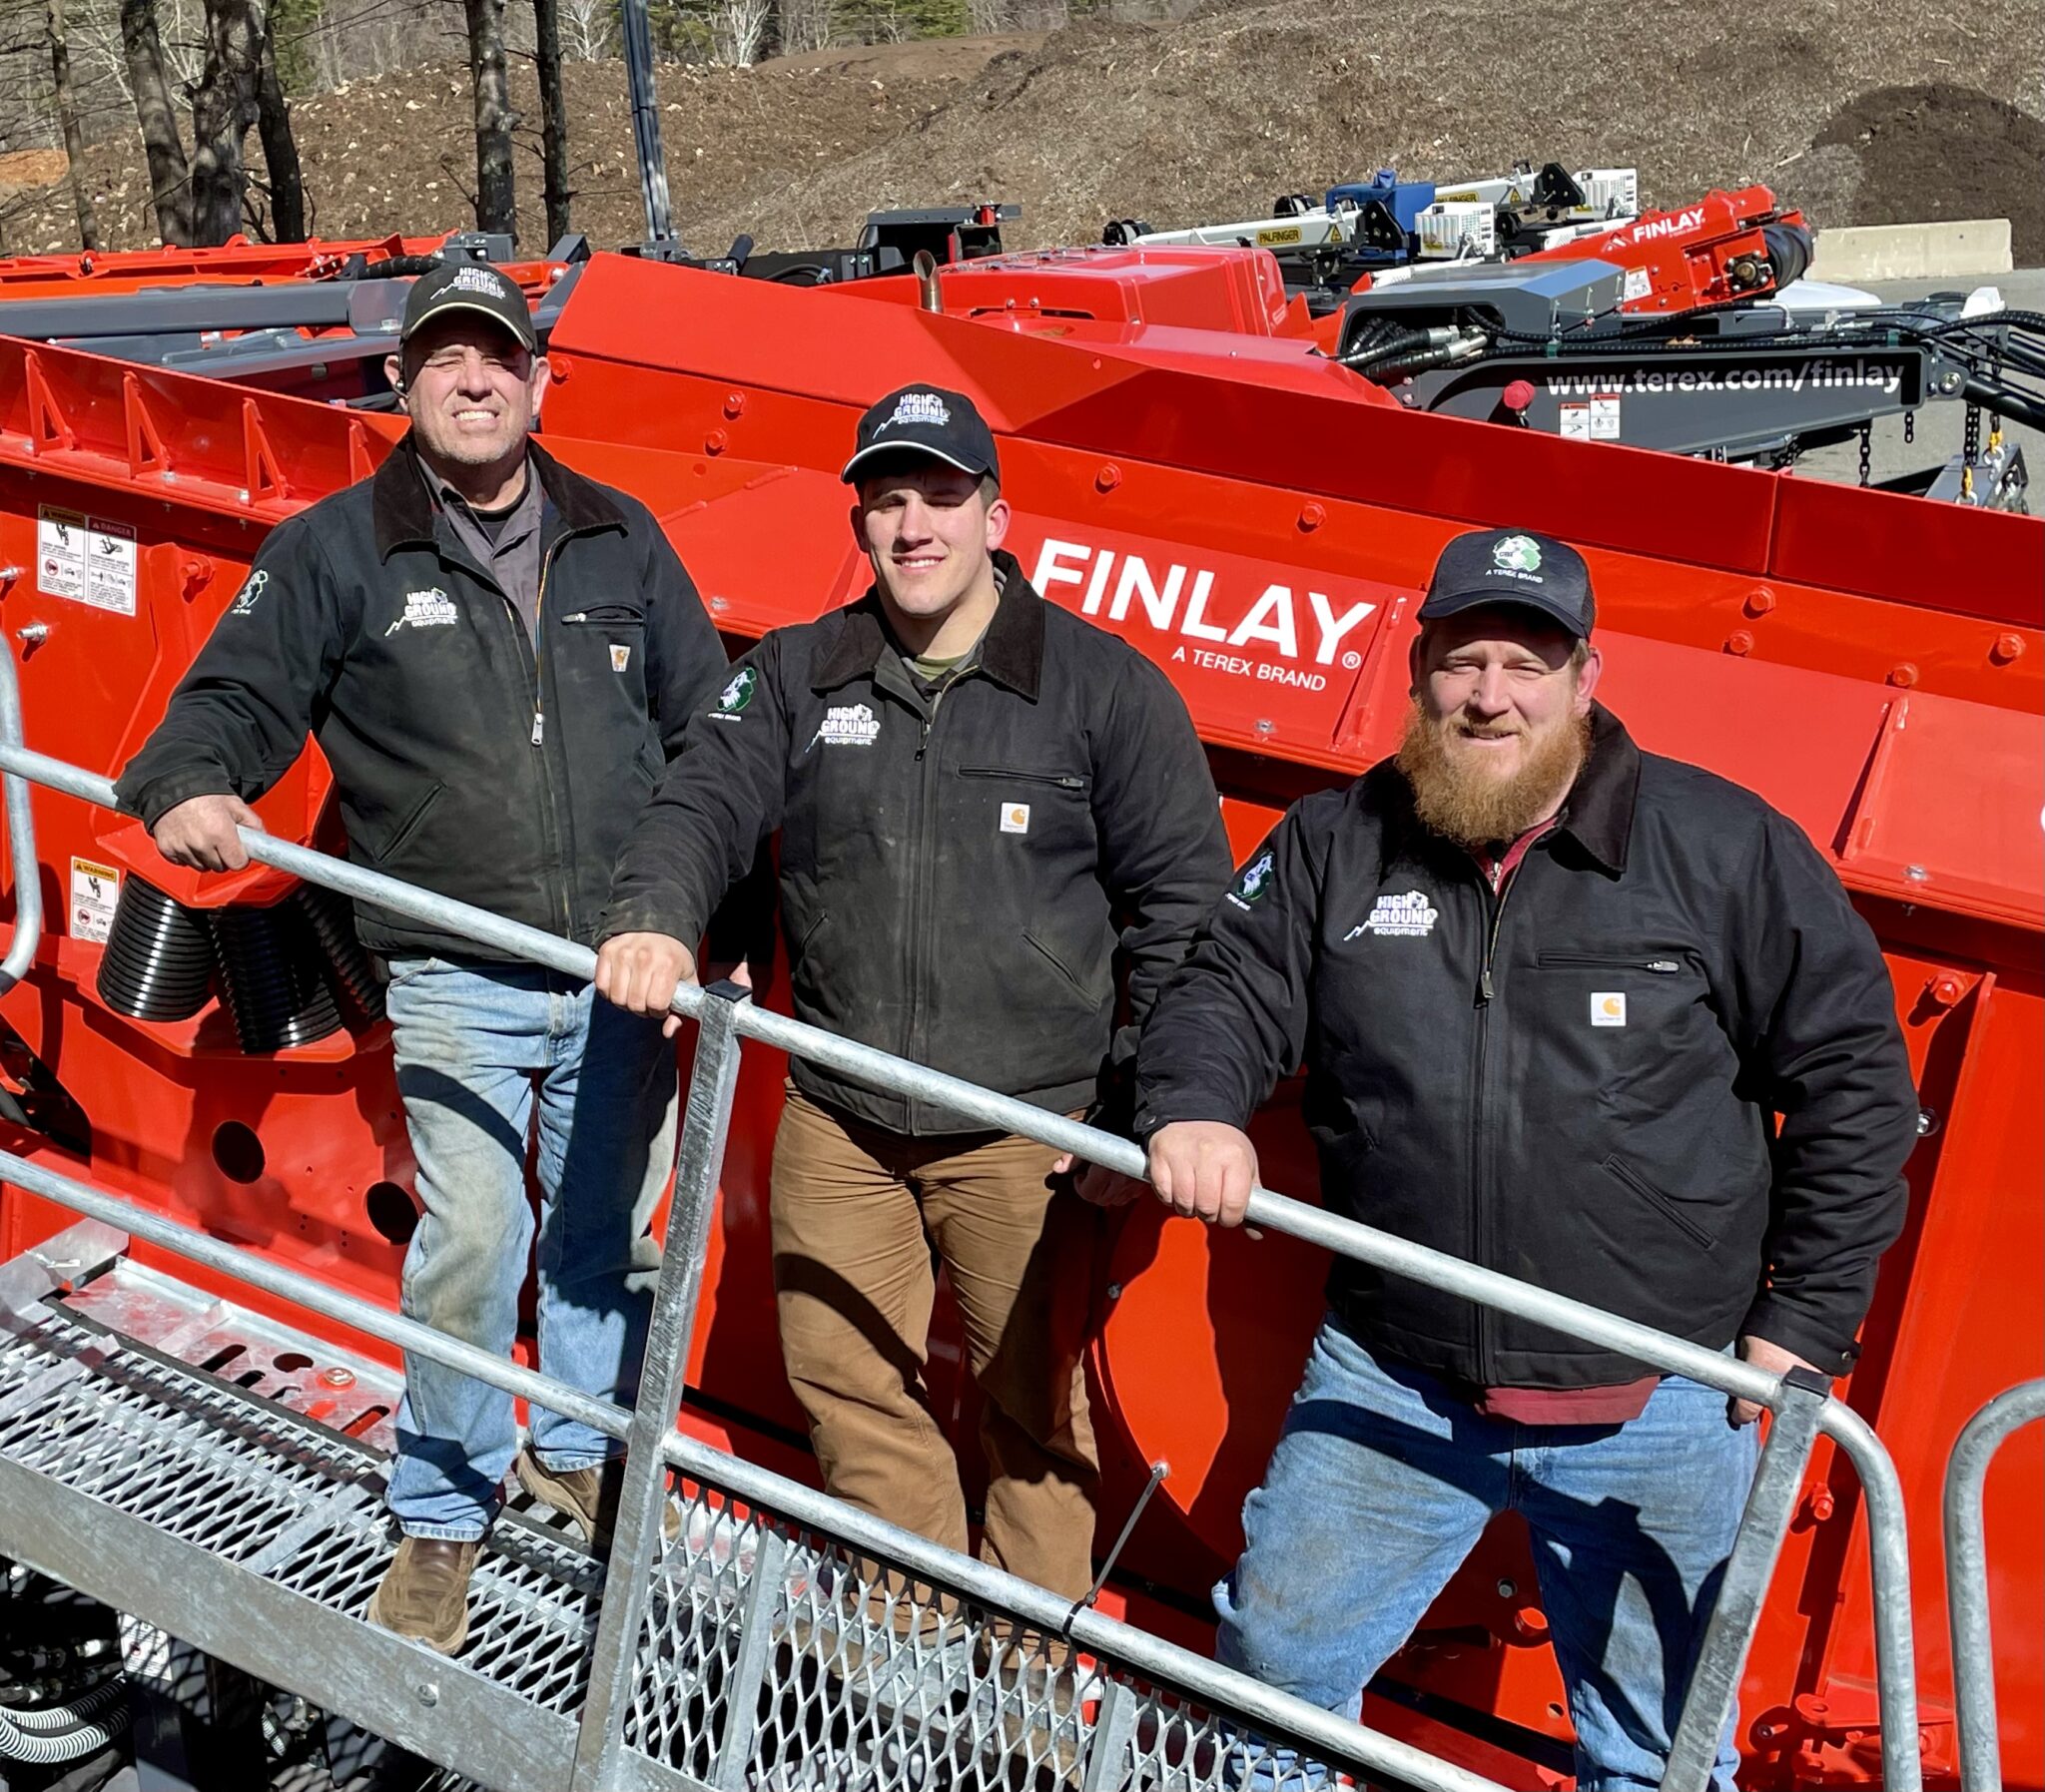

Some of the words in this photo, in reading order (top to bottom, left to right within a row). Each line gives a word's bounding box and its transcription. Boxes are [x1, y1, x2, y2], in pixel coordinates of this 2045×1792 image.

[1633, 208, 1704, 243] FINLAY
[1259, 230, 1299, 244] PALFINGER
[1547, 358, 1904, 395] www.terex.com/finlay
[900, 393, 931, 406] HIGH
[894, 404, 950, 419] GROUND
[406, 590, 436, 605] HIGH
[404, 602, 457, 618] GROUND
[1171, 646, 1186, 662] A
[1192, 649, 1253, 677] TEREX
[1256, 664, 1326, 692] BRAND
[827, 706, 859, 721] HIGH
[821, 720, 880, 735] GROUND
[1377, 895, 1411, 909] HIGH
[1369, 908, 1437, 924] GROUND
[1373, 926, 1429, 936] equipment
